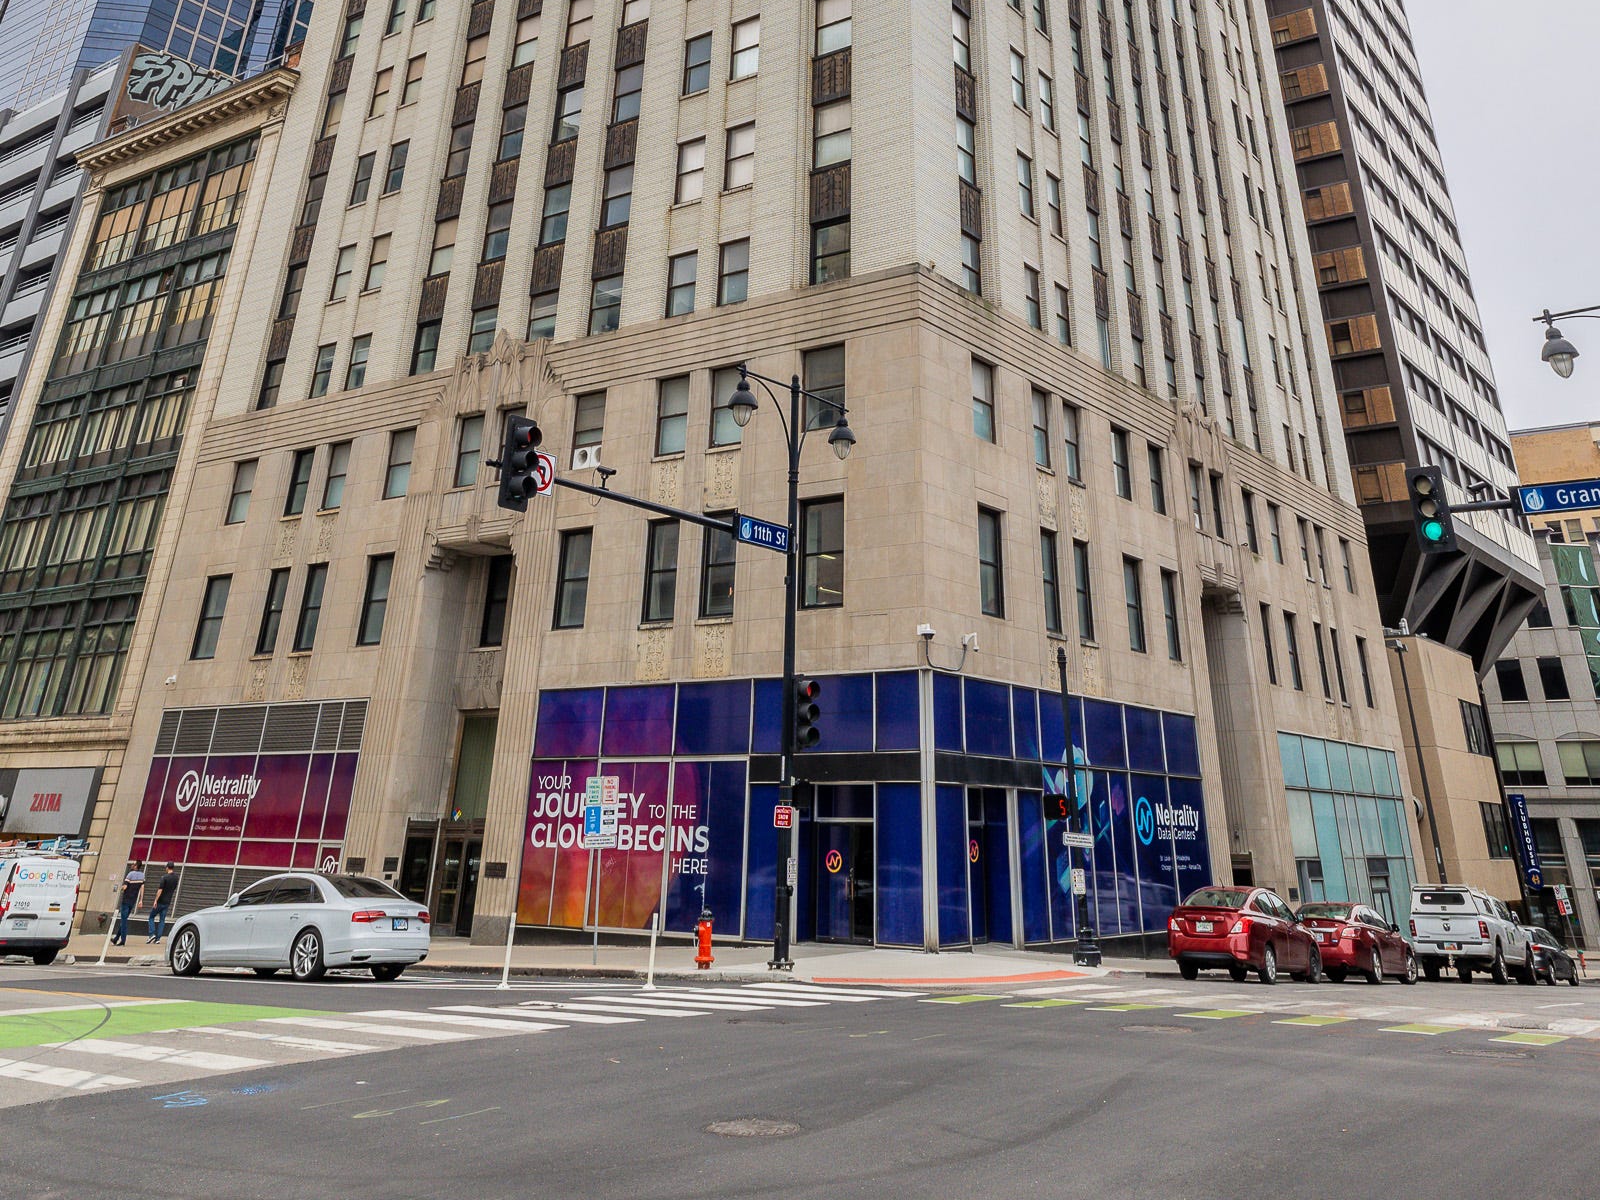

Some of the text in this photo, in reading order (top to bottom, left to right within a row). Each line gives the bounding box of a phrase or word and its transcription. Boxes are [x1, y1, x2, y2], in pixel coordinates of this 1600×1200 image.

[754, 525, 772, 542] 11th
[776, 531, 785, 545] St
[202, 774, 261, 799] Netrality
[538, 776, 571, 790] YOUR
[199, 796, 248, 807] Data Centers
[533, 793, 645, 818] JOUEY
[1059, 799, 1066, 816] 5
[649, 805, 697, 819] TO THE
[1155, 803, 1199, 831] Netrality
[531, 823, 710, 853] CLO BEGINS
[1158, 827, 1196, 840] Data Centers
[1518, 801, 1535, 866] CLUBHOUSE
[672, 858, 709, 874] HERE
[20, 869, 75, 882] Google Fiber
